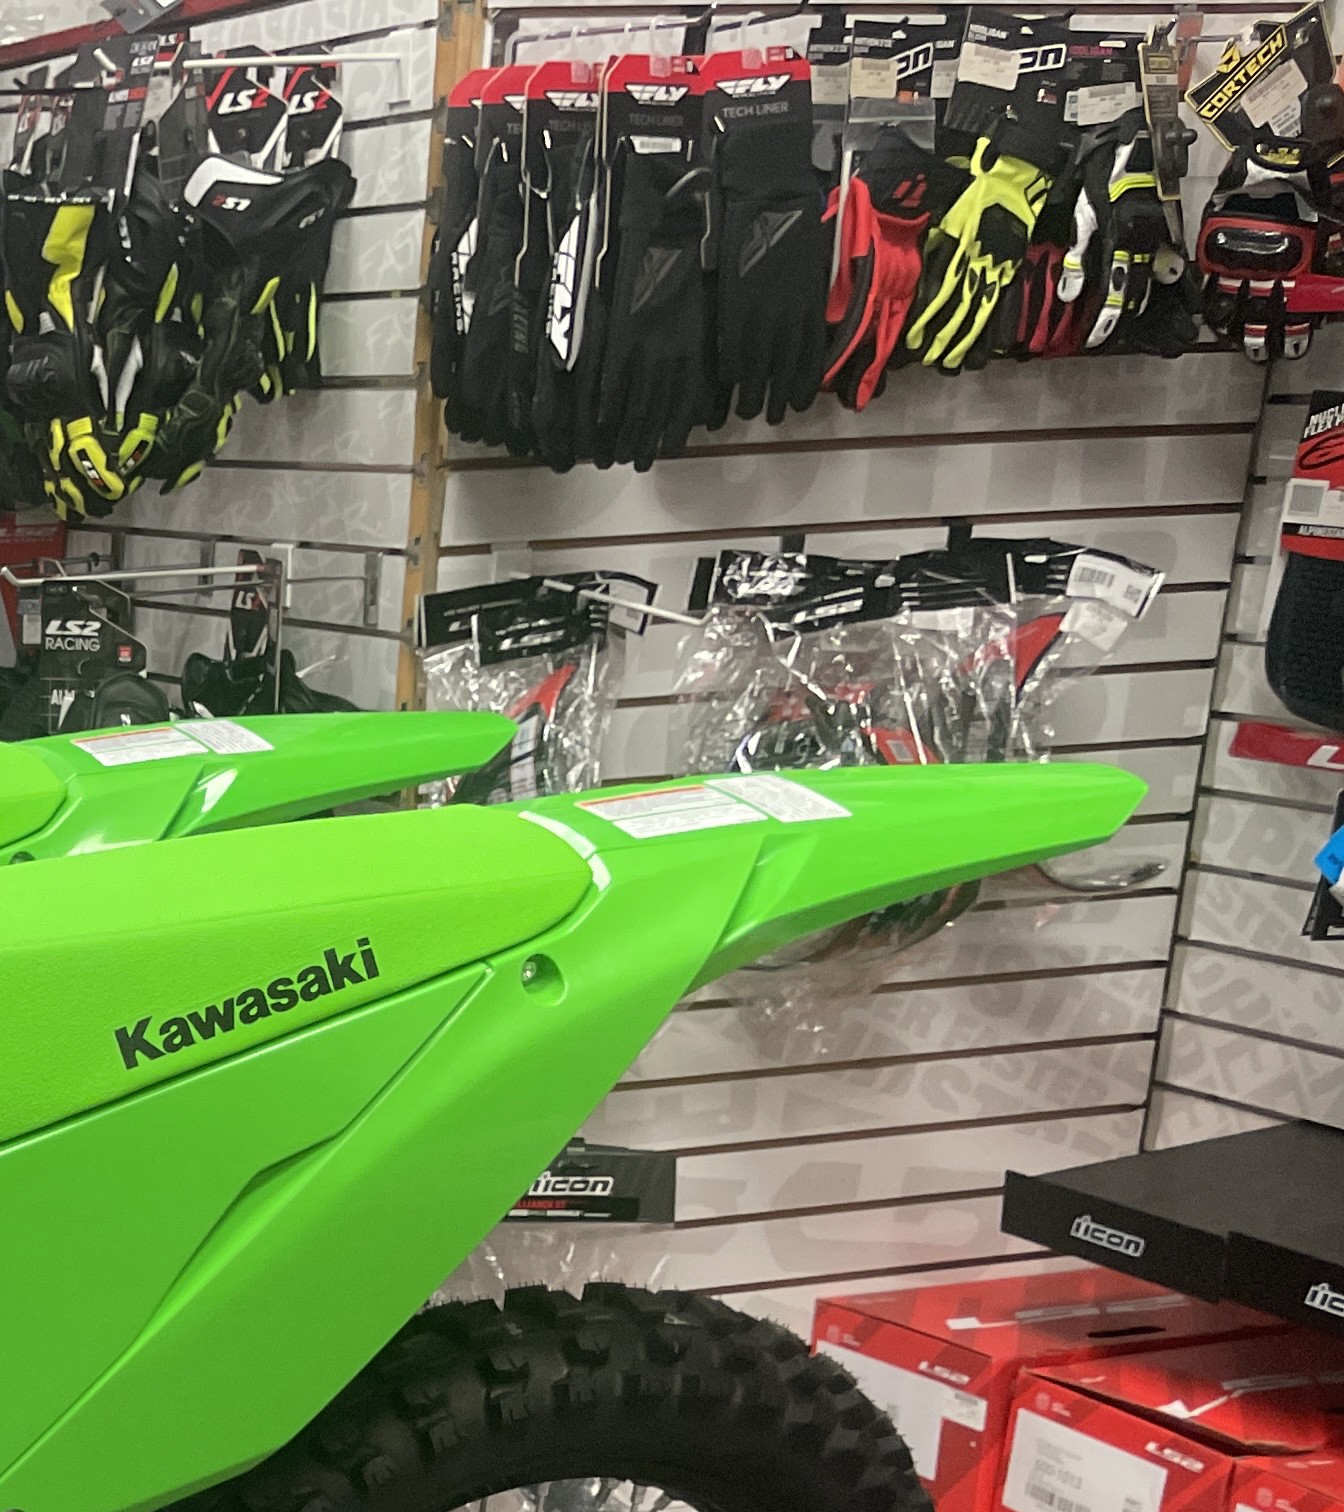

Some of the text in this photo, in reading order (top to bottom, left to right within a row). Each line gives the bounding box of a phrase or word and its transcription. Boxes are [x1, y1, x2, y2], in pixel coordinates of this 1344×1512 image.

[1199, 31, 1284, 119] CORTECH
[218, 88, 269, 115] LS2
[289, 90, 334, 114] LS2
[722, 101, 790, 119] TECH LINER
[1303, 415, 1334, 439] FLEX
[45, 620, 102, 637] LS2
[45, 637, 101, 652] RACING
[114, 937, 381, 1069] Kawasaki
[515, 1199, 553, 1209] LLIANCE
